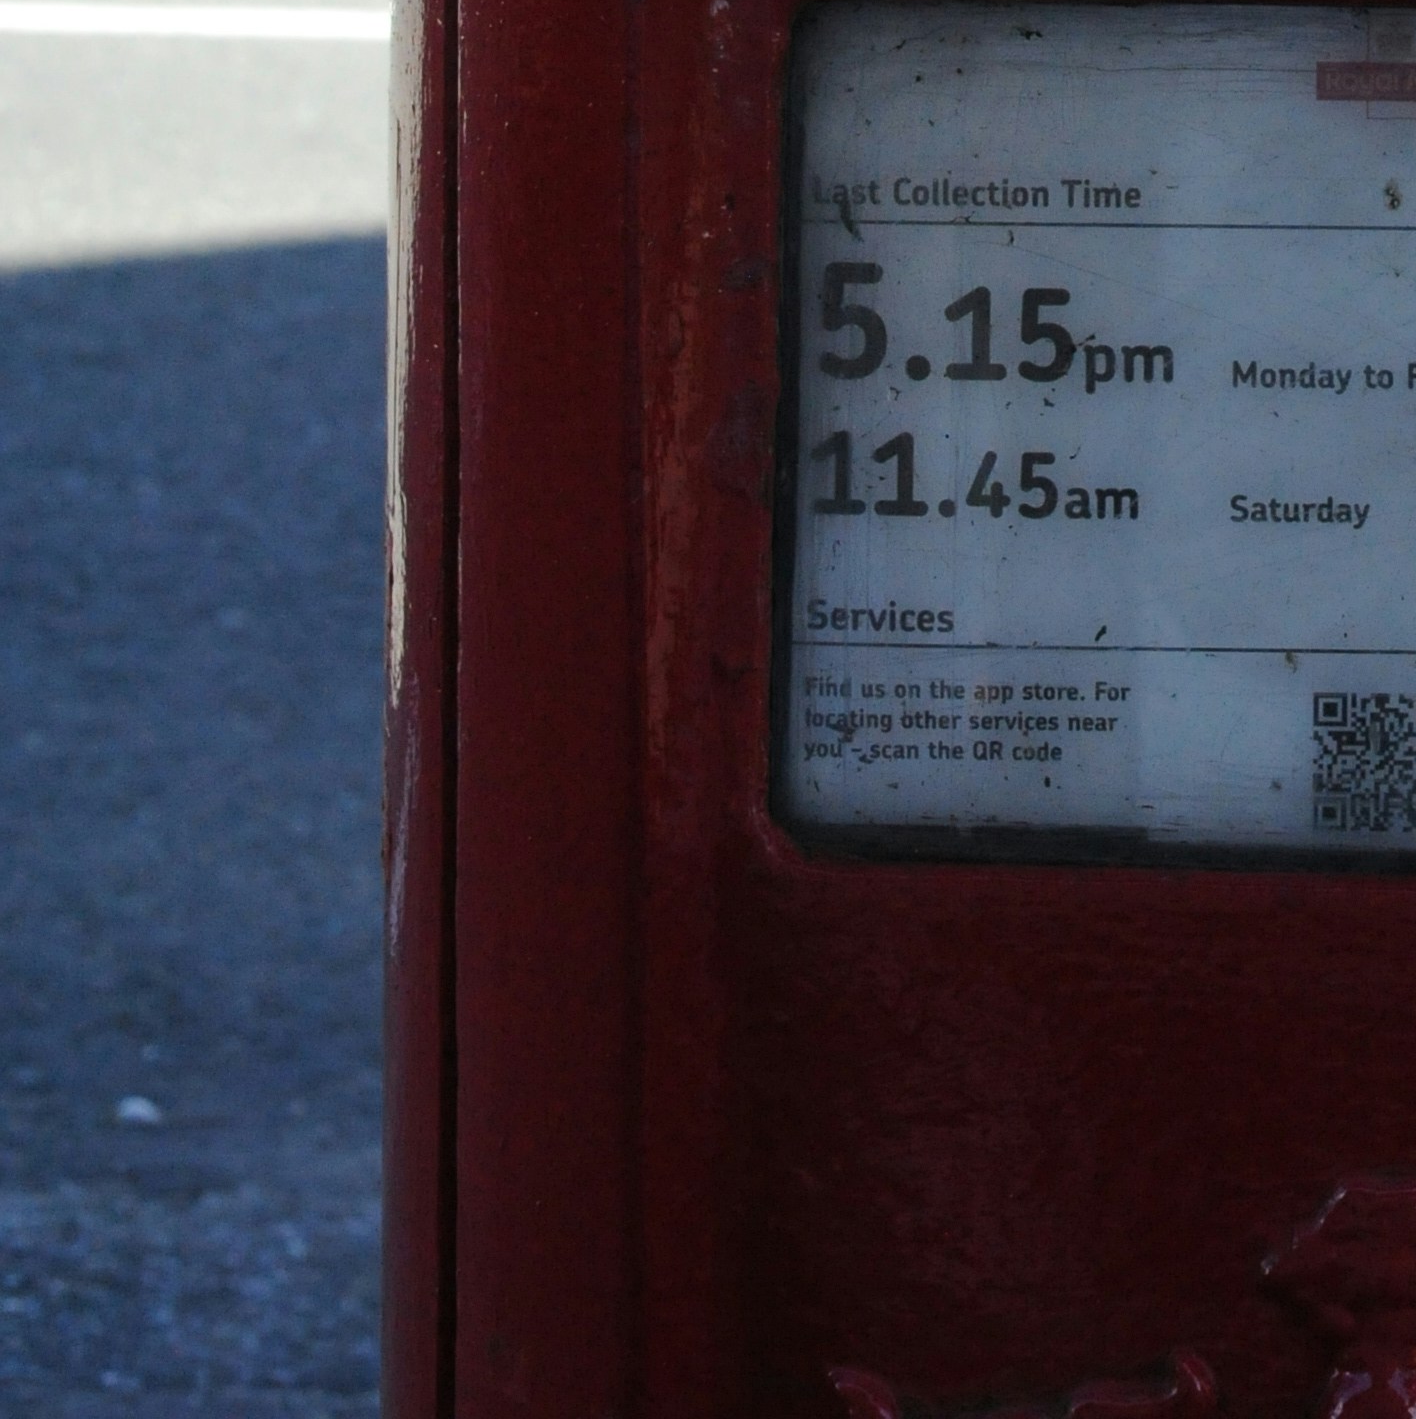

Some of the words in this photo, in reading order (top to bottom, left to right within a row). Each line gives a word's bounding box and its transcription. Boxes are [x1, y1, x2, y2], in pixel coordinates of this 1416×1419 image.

[813, 177, 880, 206] Last
[893, 178, 1049, 207] Collection
[1061, 179, 1142, 208] Time
[819, 261, 1174, 394] 5.15pm
[1232, 361, 1352, 394] Monday
[1363, 365, 1393, 389] to
[811, 430, 1139, 519] 11.45am
[1230, 495, 1370, 529] Saturday
[807, 599, 954, 632] Services
[804, 677, 851, 698] Find
[861, 683, 885, 698] us
[895, 683, 920, 699] on
[930, 682, 965, 700] the
[974, 686, 1013, 704] app
[1023, 685, 1084, 701] store.
[1095, 682, 1131, 701] For
[804, 709, 892, 733] locating
[901, 710, 959, 730] other
[969, 712, 1058, 731] services
[1068, 716, 1118, 732] near
[804, 742, 842, 760] you
[870, 744, 919, 760] scan
[929, 741, 963, 759] the
[973, 741, 1003, 760] QR
[1012, 742, 1062, 761] code
